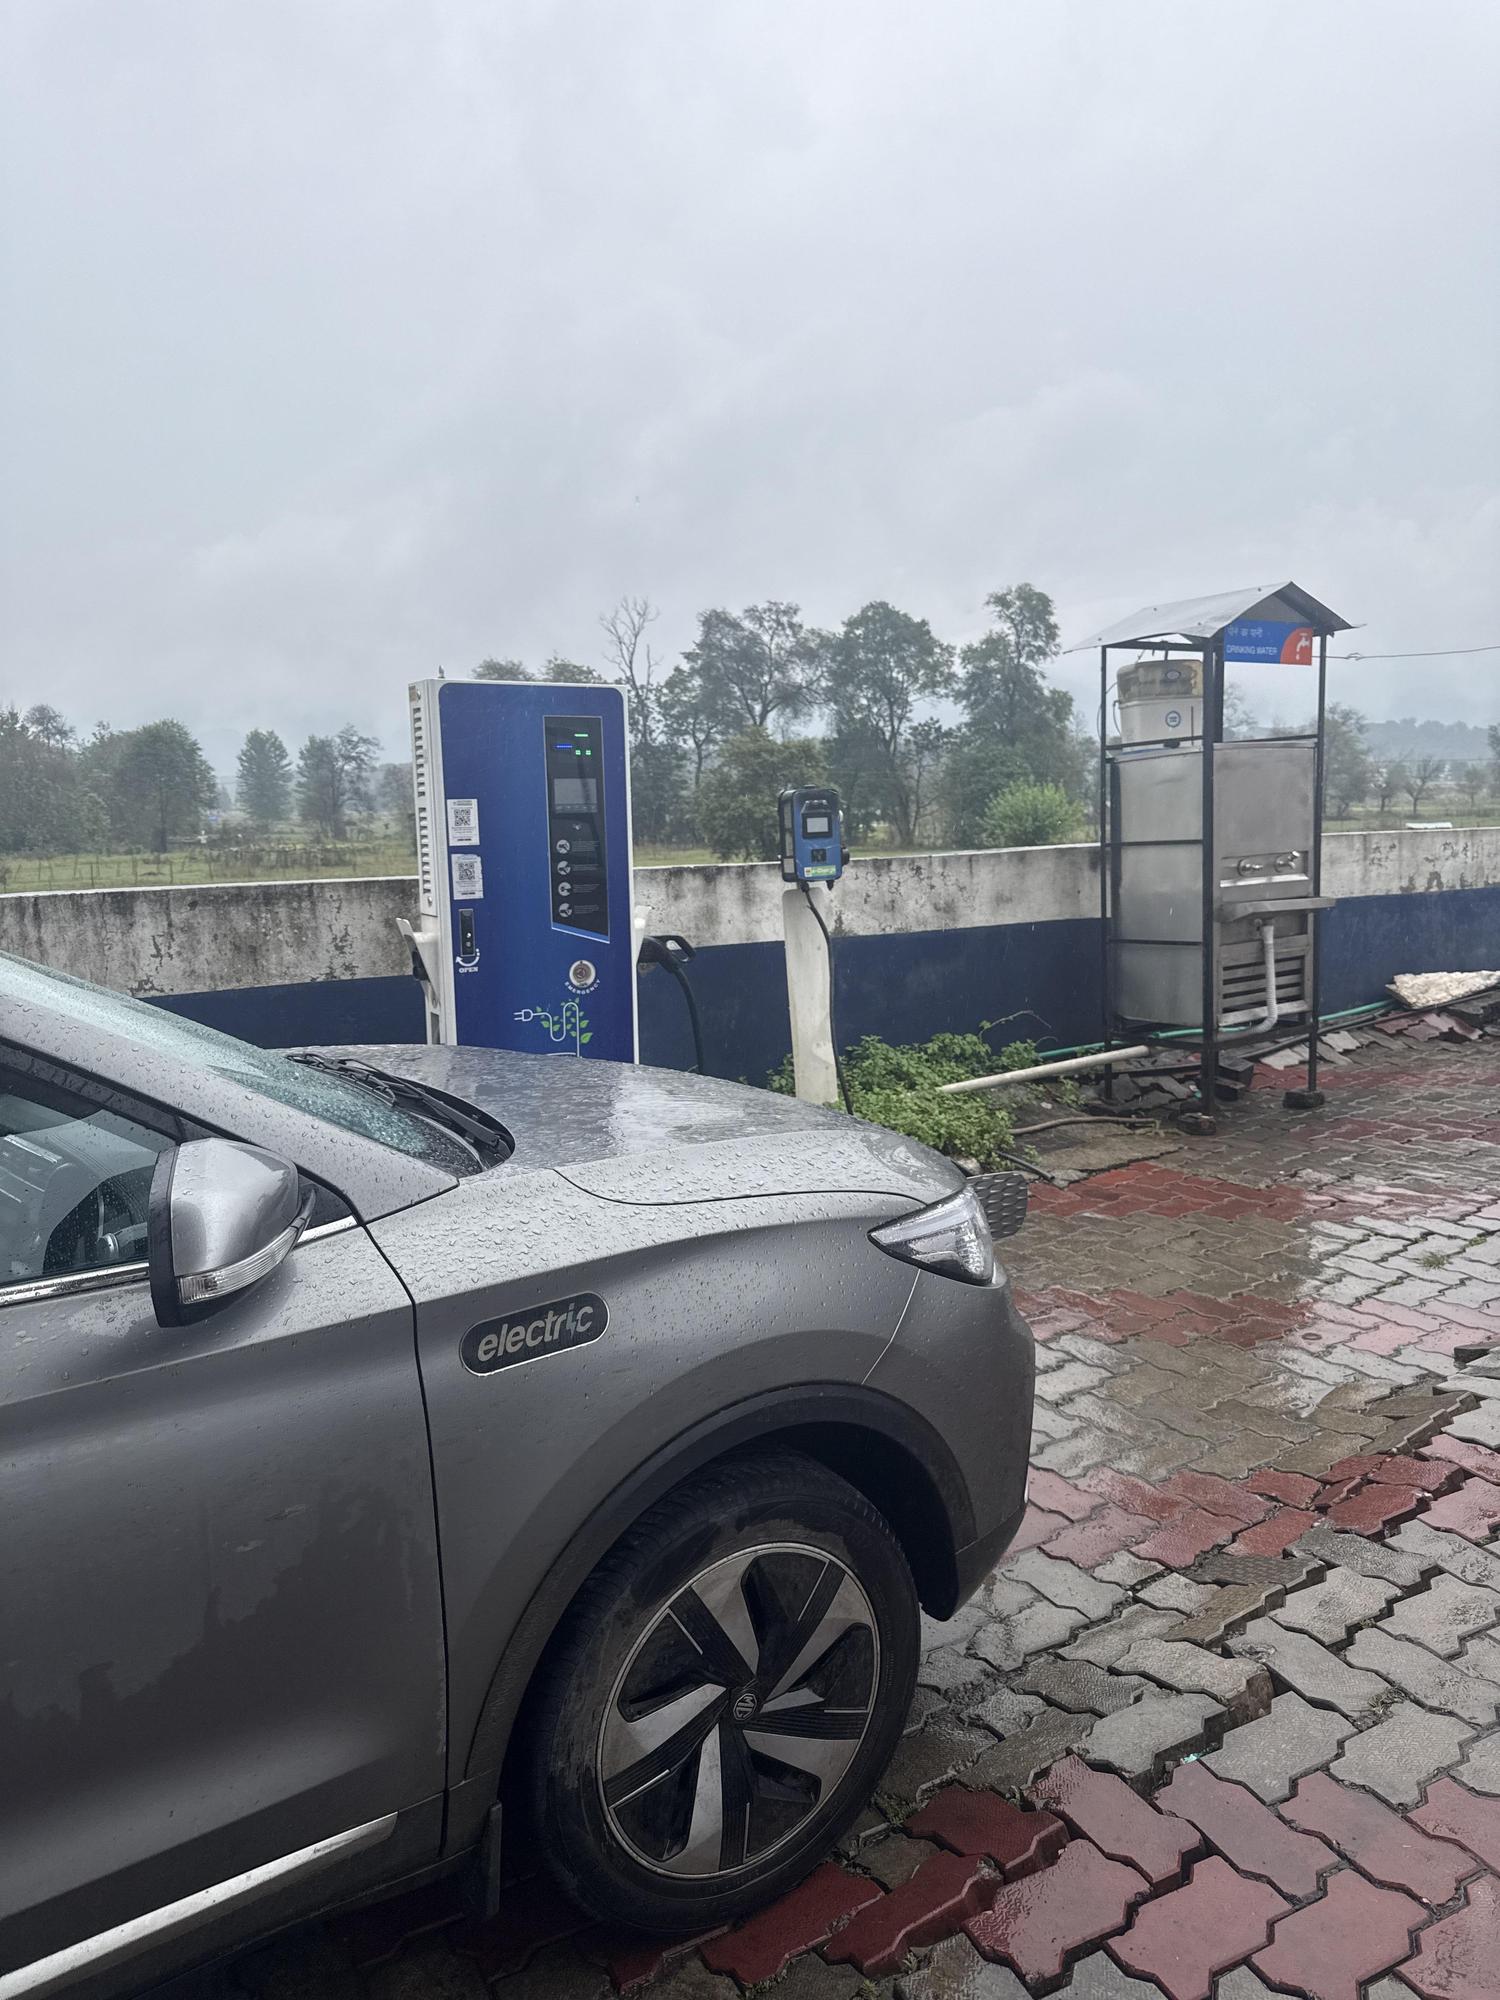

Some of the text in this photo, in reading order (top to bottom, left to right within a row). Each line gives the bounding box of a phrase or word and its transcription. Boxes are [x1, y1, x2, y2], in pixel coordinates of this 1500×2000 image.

[1226, 644, 1278, 656] DRINKING WATER
[564, 979, 600, 995] EMERGENCY
[477, 1302, 594, 1362] electric
